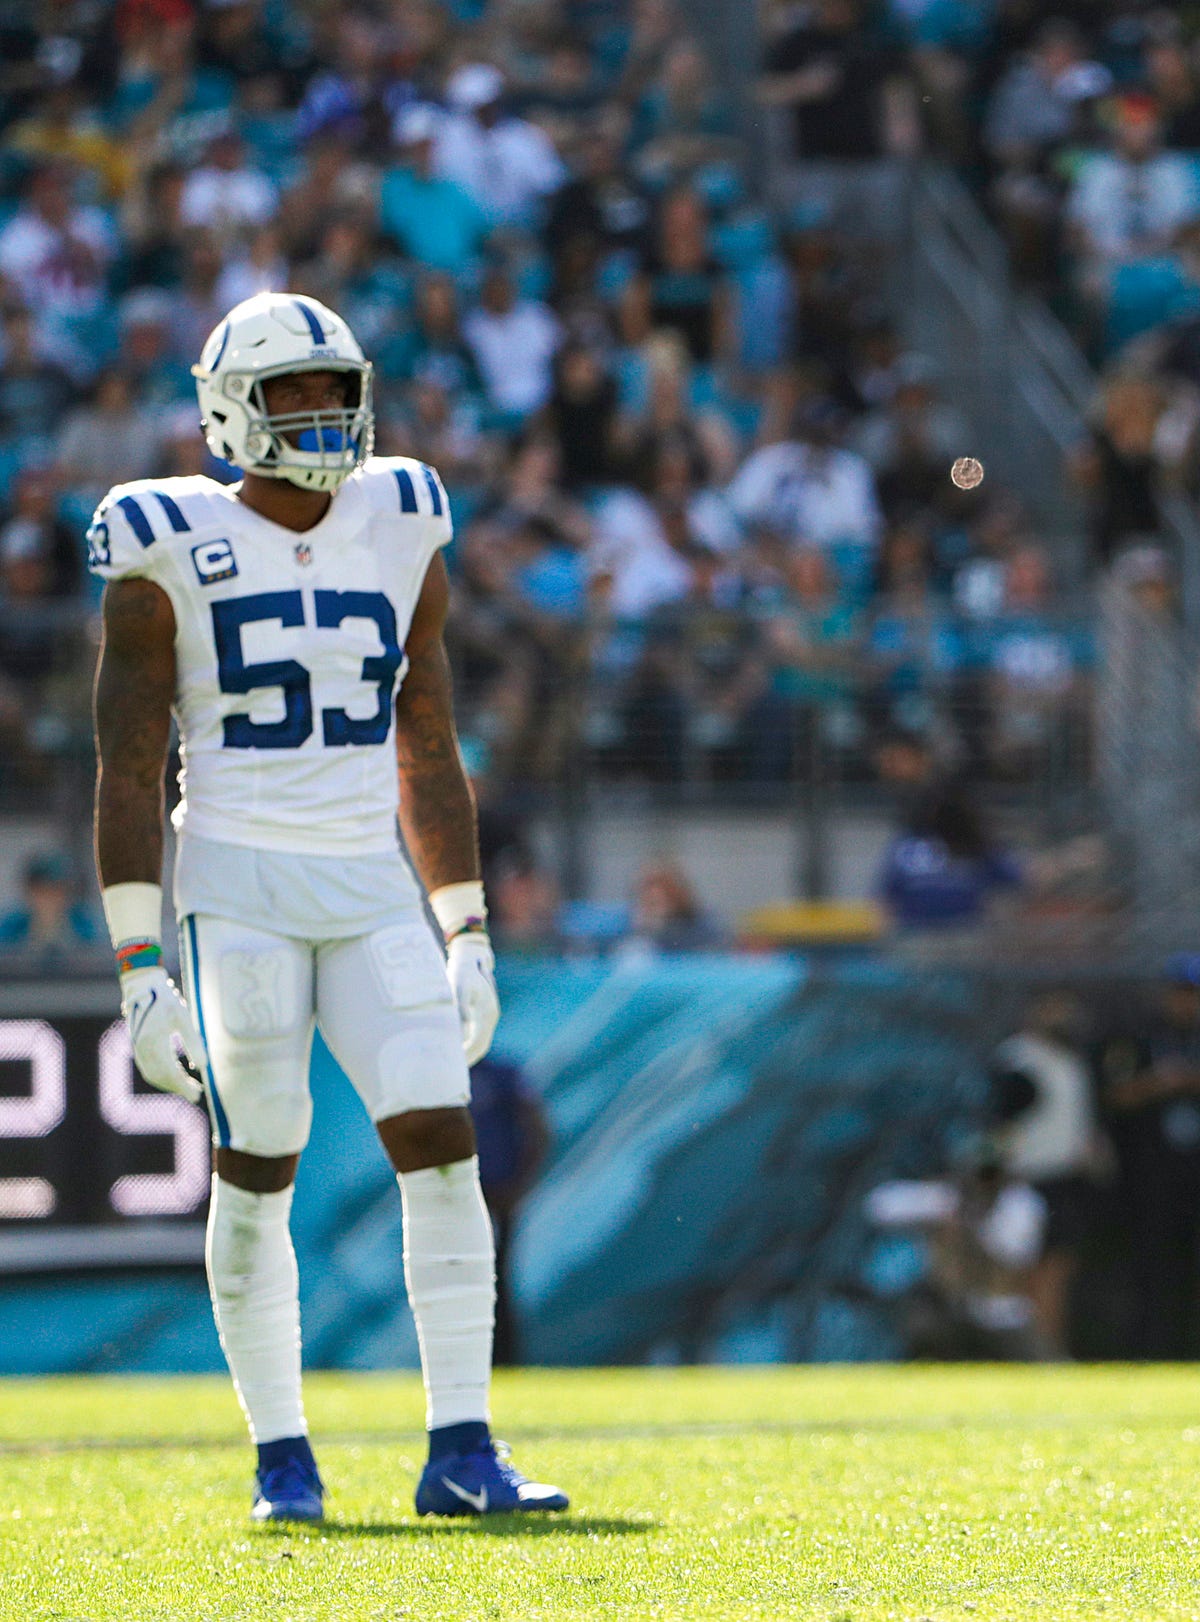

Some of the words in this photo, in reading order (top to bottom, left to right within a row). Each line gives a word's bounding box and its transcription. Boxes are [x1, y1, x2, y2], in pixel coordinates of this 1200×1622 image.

[194, 542, 234, 576] C
[211, 589, 404, 749] 53
[0, 1018, 211, 1216] 25
